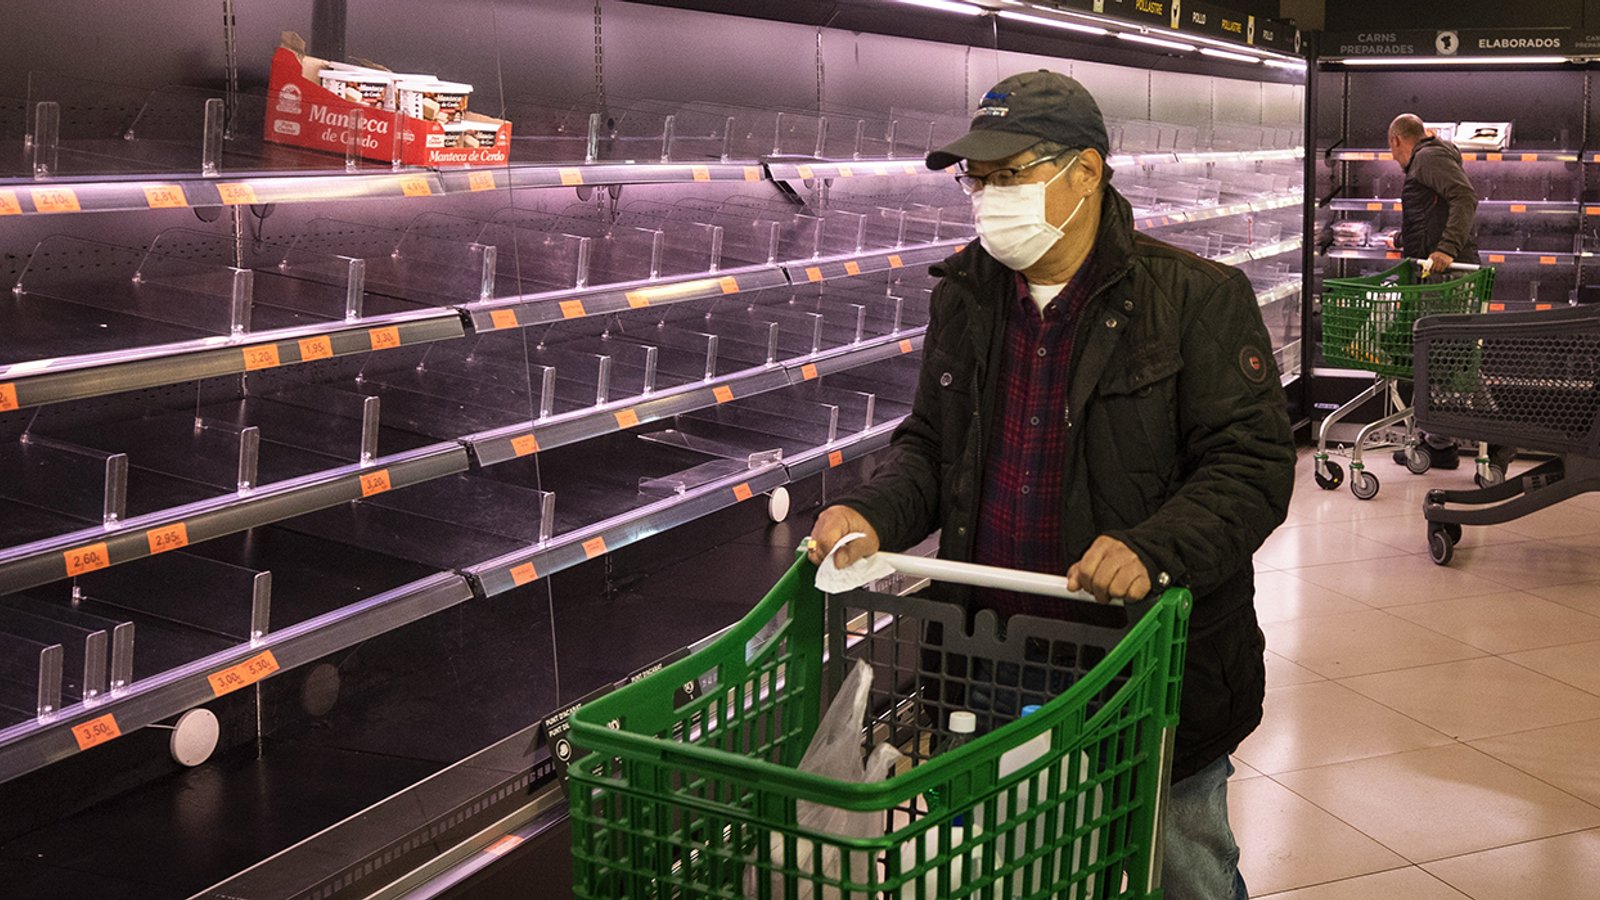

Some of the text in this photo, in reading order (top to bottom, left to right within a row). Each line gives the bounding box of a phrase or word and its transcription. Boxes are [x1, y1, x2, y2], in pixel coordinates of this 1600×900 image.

[1358, 33, 1397, 42] CARNS
[1478, 38, 1560, 48] ELABORADOS
[1340, 44, 1414, 54] PREPARADES
[308, 104, 389, 134] Maneca
[321, 127, 338, 142] de
[429, 150, 505, 162] Manteca de Cerdo
